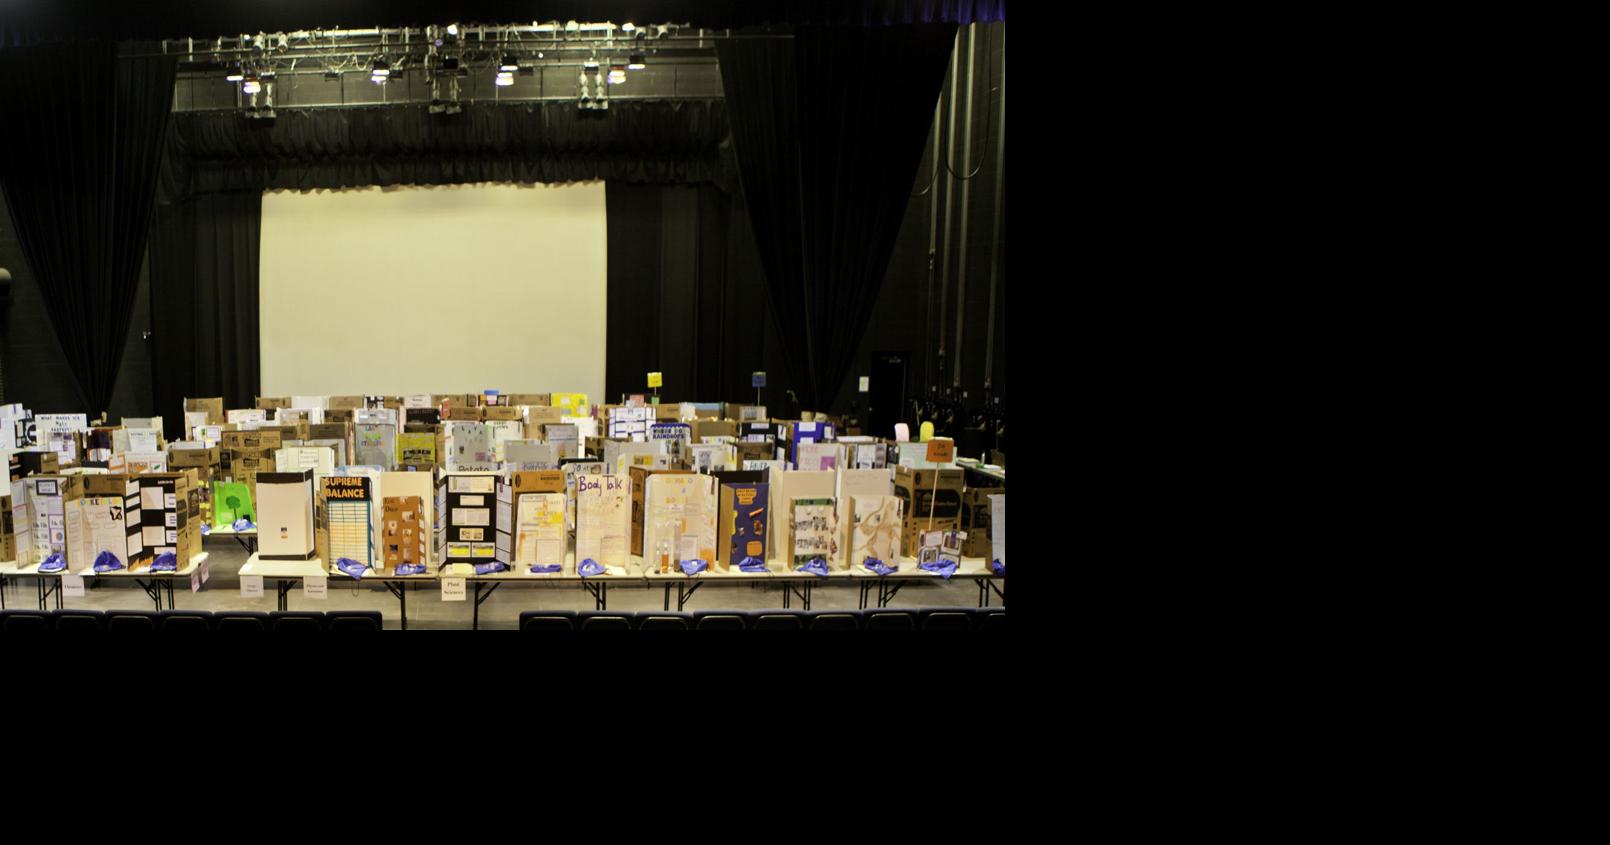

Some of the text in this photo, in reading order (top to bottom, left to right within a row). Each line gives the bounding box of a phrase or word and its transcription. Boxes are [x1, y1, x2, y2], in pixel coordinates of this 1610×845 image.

[325, 477, 363, 486] SUPREME
[578, 474, 623, 497] Body Talk
[326, 488, 365, 498] BALANCE
